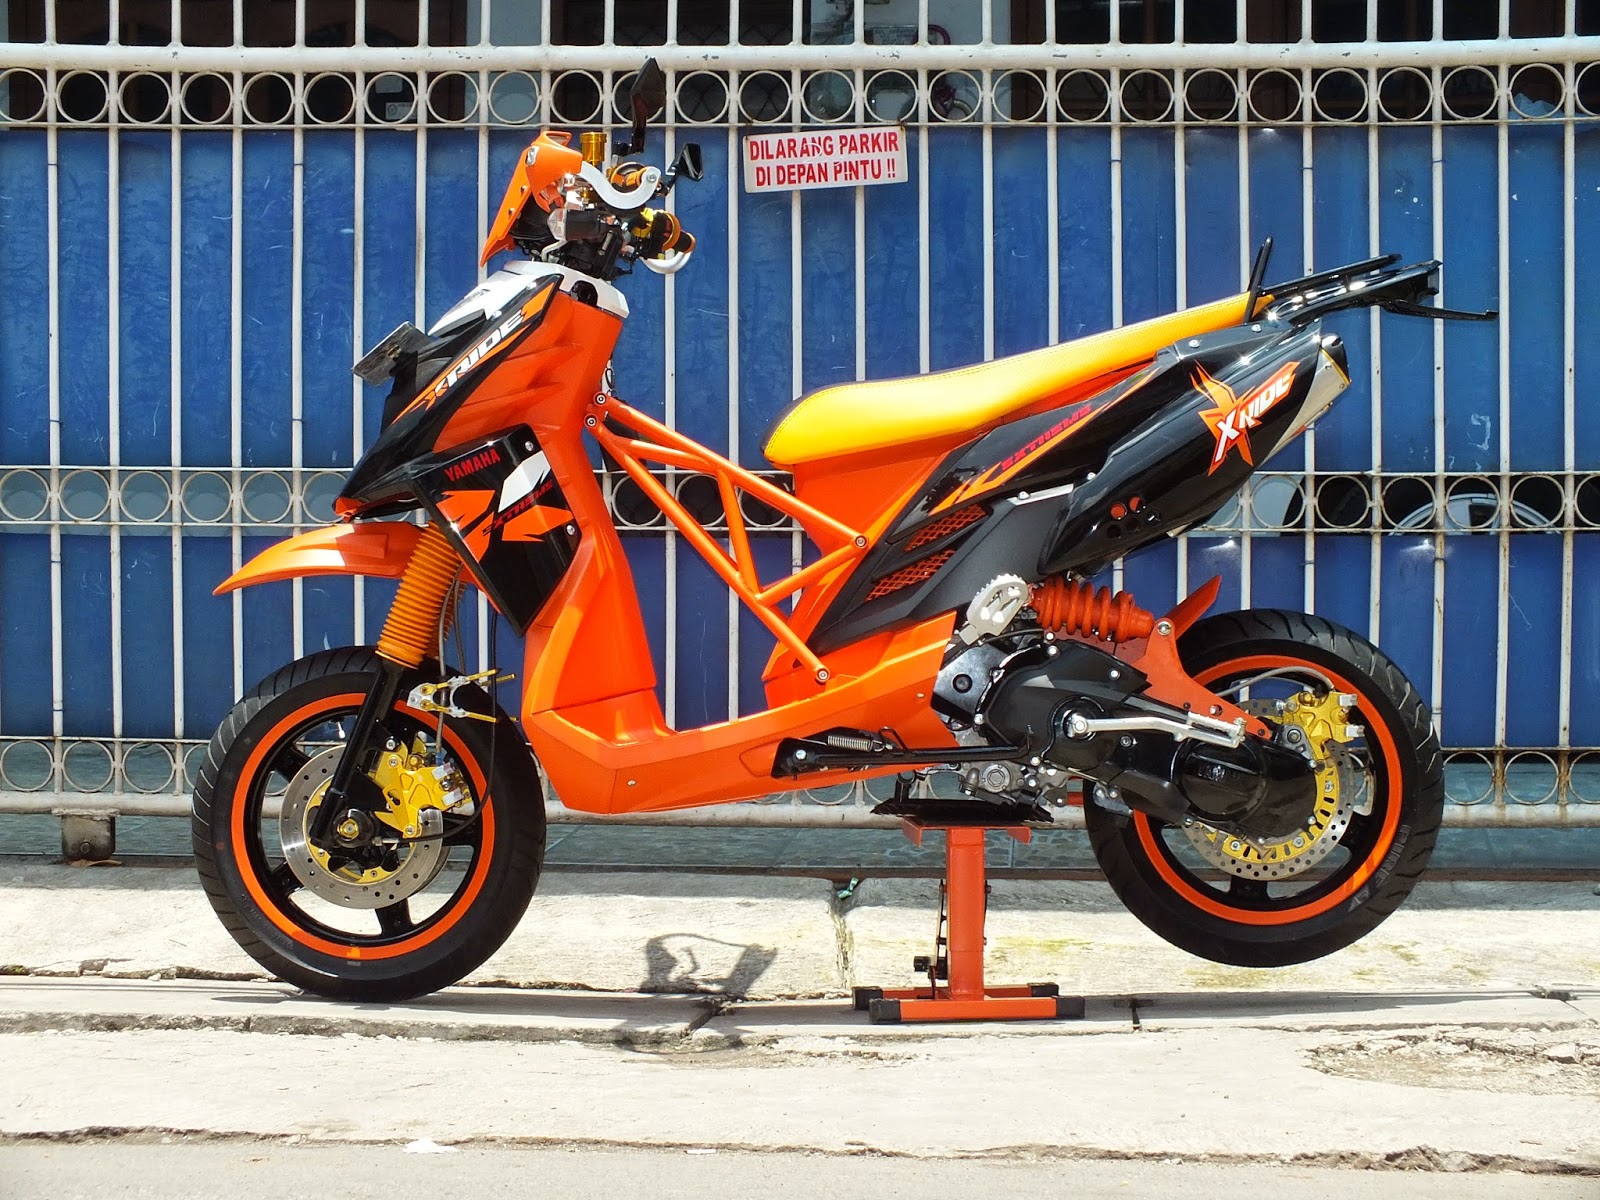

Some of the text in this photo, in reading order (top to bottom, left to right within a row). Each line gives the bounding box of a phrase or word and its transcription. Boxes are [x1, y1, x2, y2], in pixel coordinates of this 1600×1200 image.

[750, 131, 899, 161] DILARANG PARKIR
[756, 166, 772, 187] DI
[776, 162, 829, 185] DEPAN
[834, 159, 882, 182] PINTU
[444, 448, 501, 481] YAMAHA
